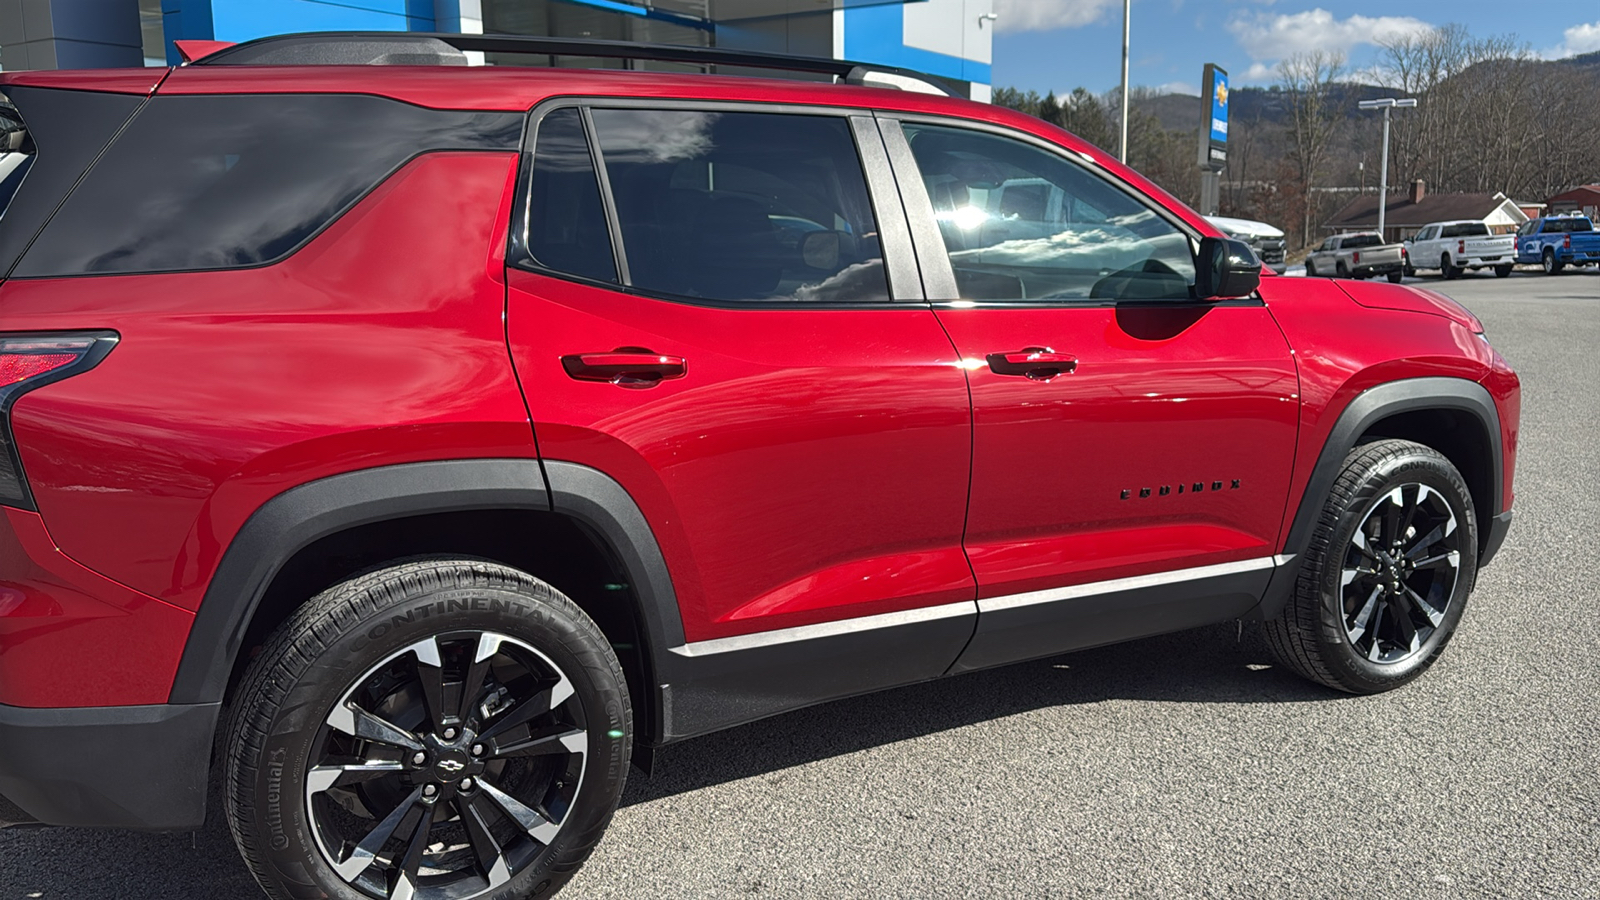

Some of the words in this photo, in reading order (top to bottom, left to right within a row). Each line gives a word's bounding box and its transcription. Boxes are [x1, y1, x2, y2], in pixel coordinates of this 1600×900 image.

[1119, 479, 1241, 500] EQUINOX
[352, 598, 559, 653] CONTINENTAL
[265, 759, 289, 851] Continental
